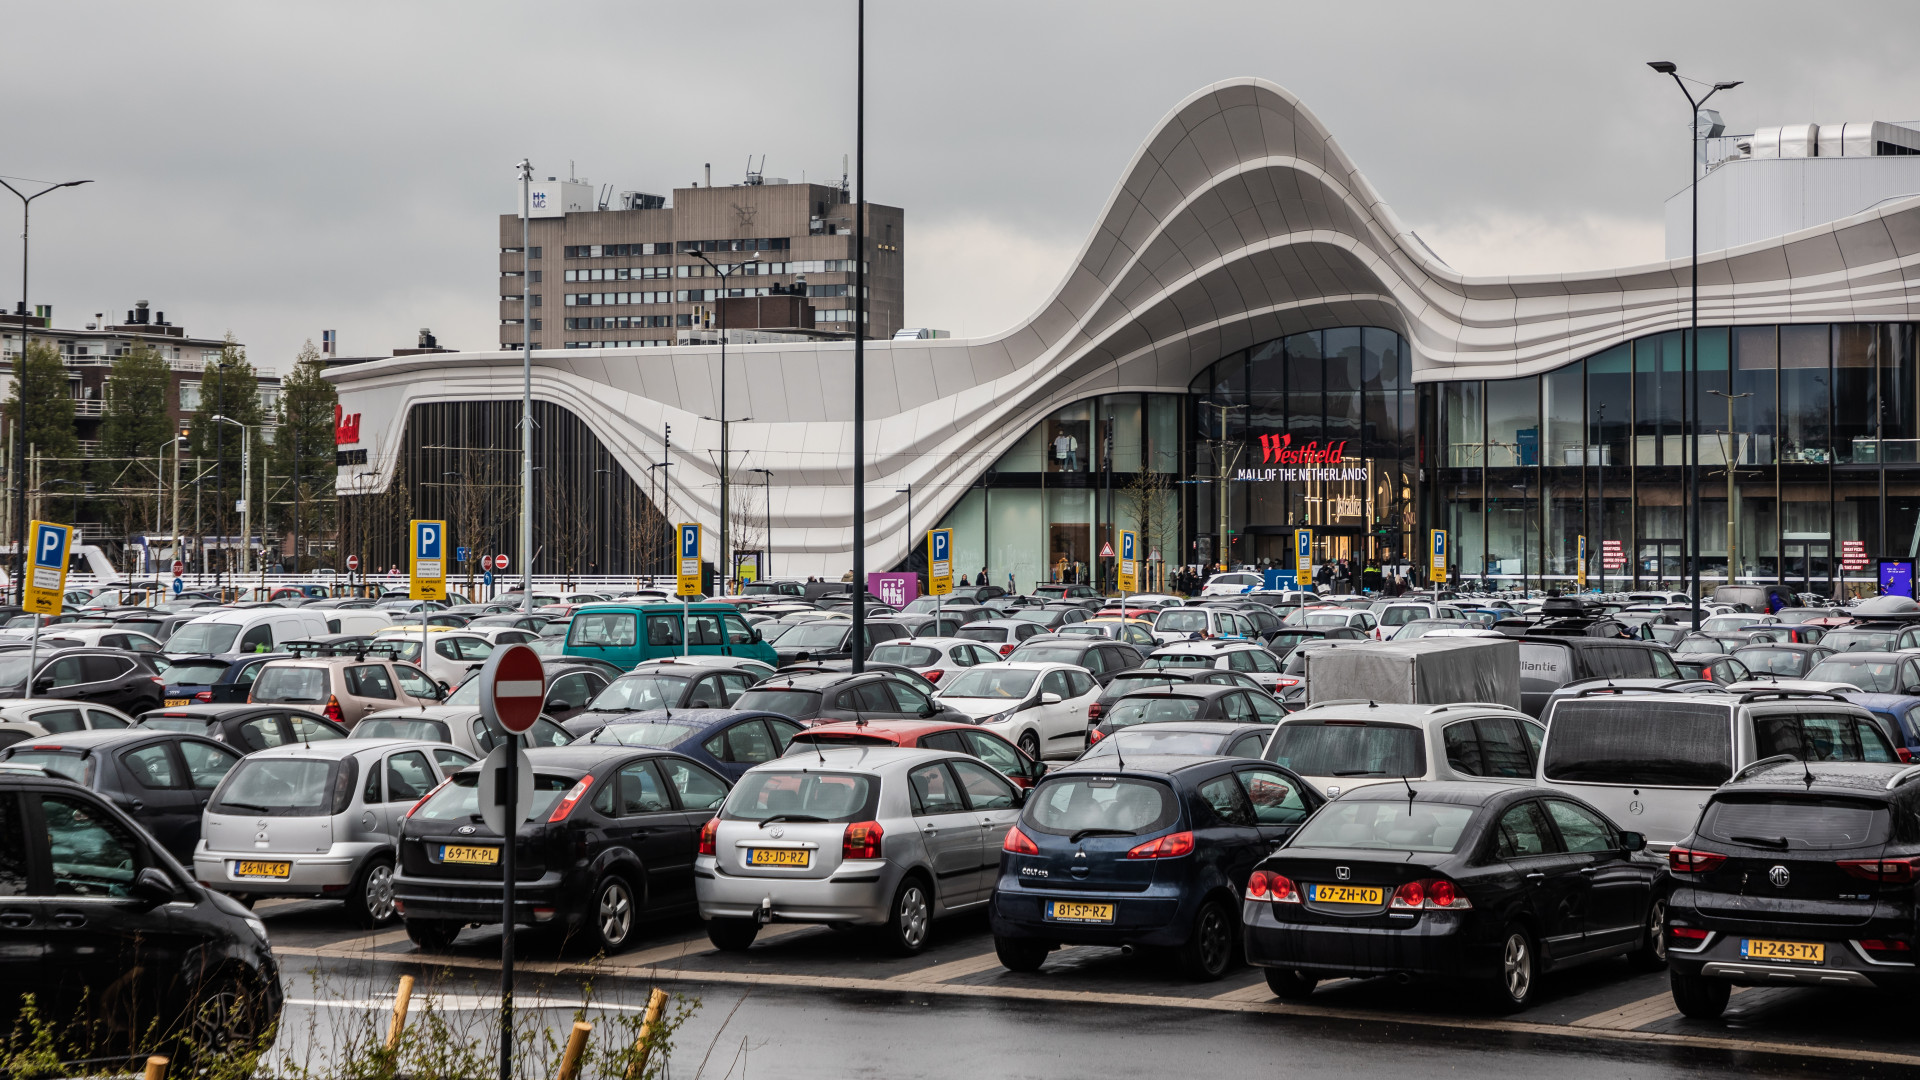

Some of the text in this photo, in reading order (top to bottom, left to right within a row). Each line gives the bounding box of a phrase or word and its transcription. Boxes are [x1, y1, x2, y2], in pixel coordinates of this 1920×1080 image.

[532, 200, 546, 208] MC
[1258, 433, 1348, 464] Westfield
[1238, 467, 1368, 482] MALL OF THE NETHERLANDS
[42, 530, 59, 561] P
[422, 528, 436, 554] P
[686, 530, 694, 554] P
[936, 536, 946, 558] P
[1125, 536, 1132, 556] P
[1301, 534, 1308, 554] P
[1436, 534, 1442, 552] P
[898, 579, 904, 588] P
[448, 848, 494, 860] 69-TK-PL
[756, 851, 804, 863] 63-JD-RZ
[242, 862, 285, 874] 36-NL-KS
[1022, 867, 1037, 876] COLT
[1770, 868, 1788, 886] MG
[1320, 888, 1377, 902] 67-ZH-KD
[1058, 904, 1107, 917] 81-SP-RZ
[1753, 942, 1818, 958] H-243-TX
